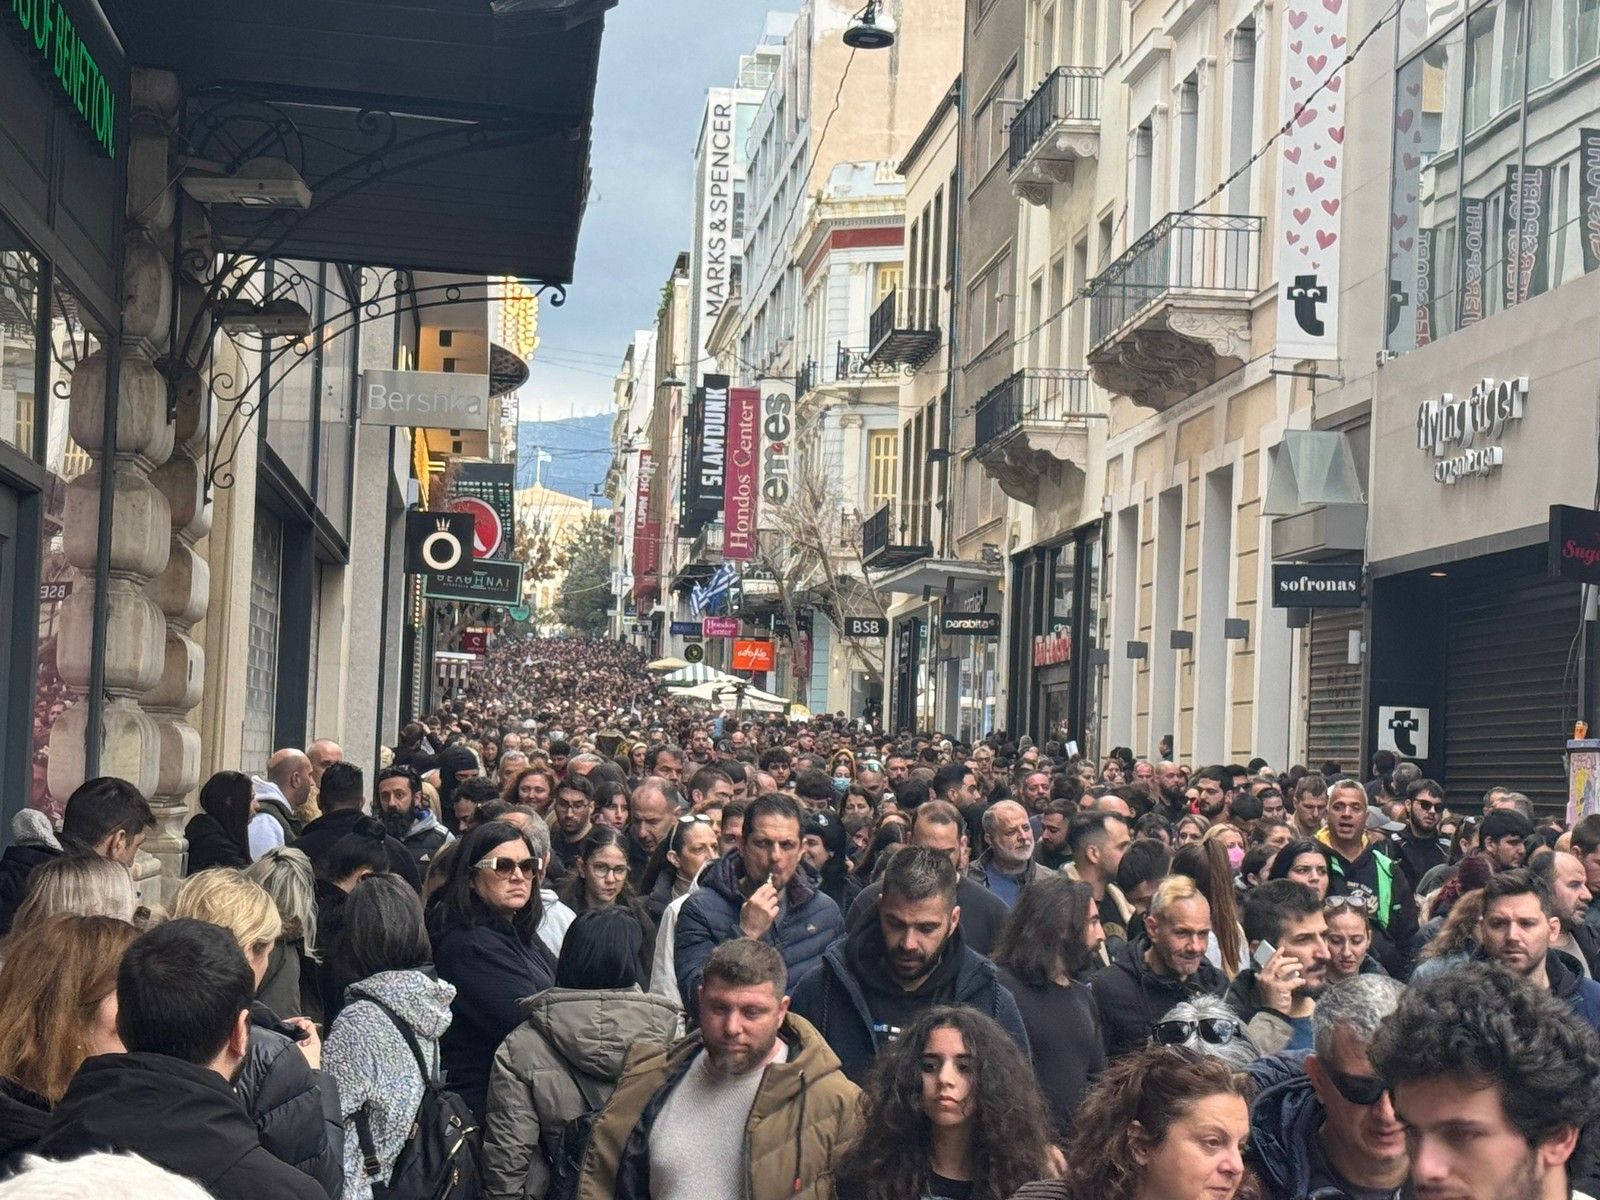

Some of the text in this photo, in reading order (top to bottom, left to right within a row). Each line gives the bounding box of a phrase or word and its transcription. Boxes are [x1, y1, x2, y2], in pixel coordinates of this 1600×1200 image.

[706, 103, 732, 318] MARKS & SPENCER
[368, 384, 481, 415] Bershka
[1417, 376, 1529, 457] flying tiger
[729, 400, 754, 549] Hondos Center
[1434, 446, 1503, 485] copenhagen
[1280, 576, 1357, 592] sofronas
[853, 620, 880, 634] BSB
